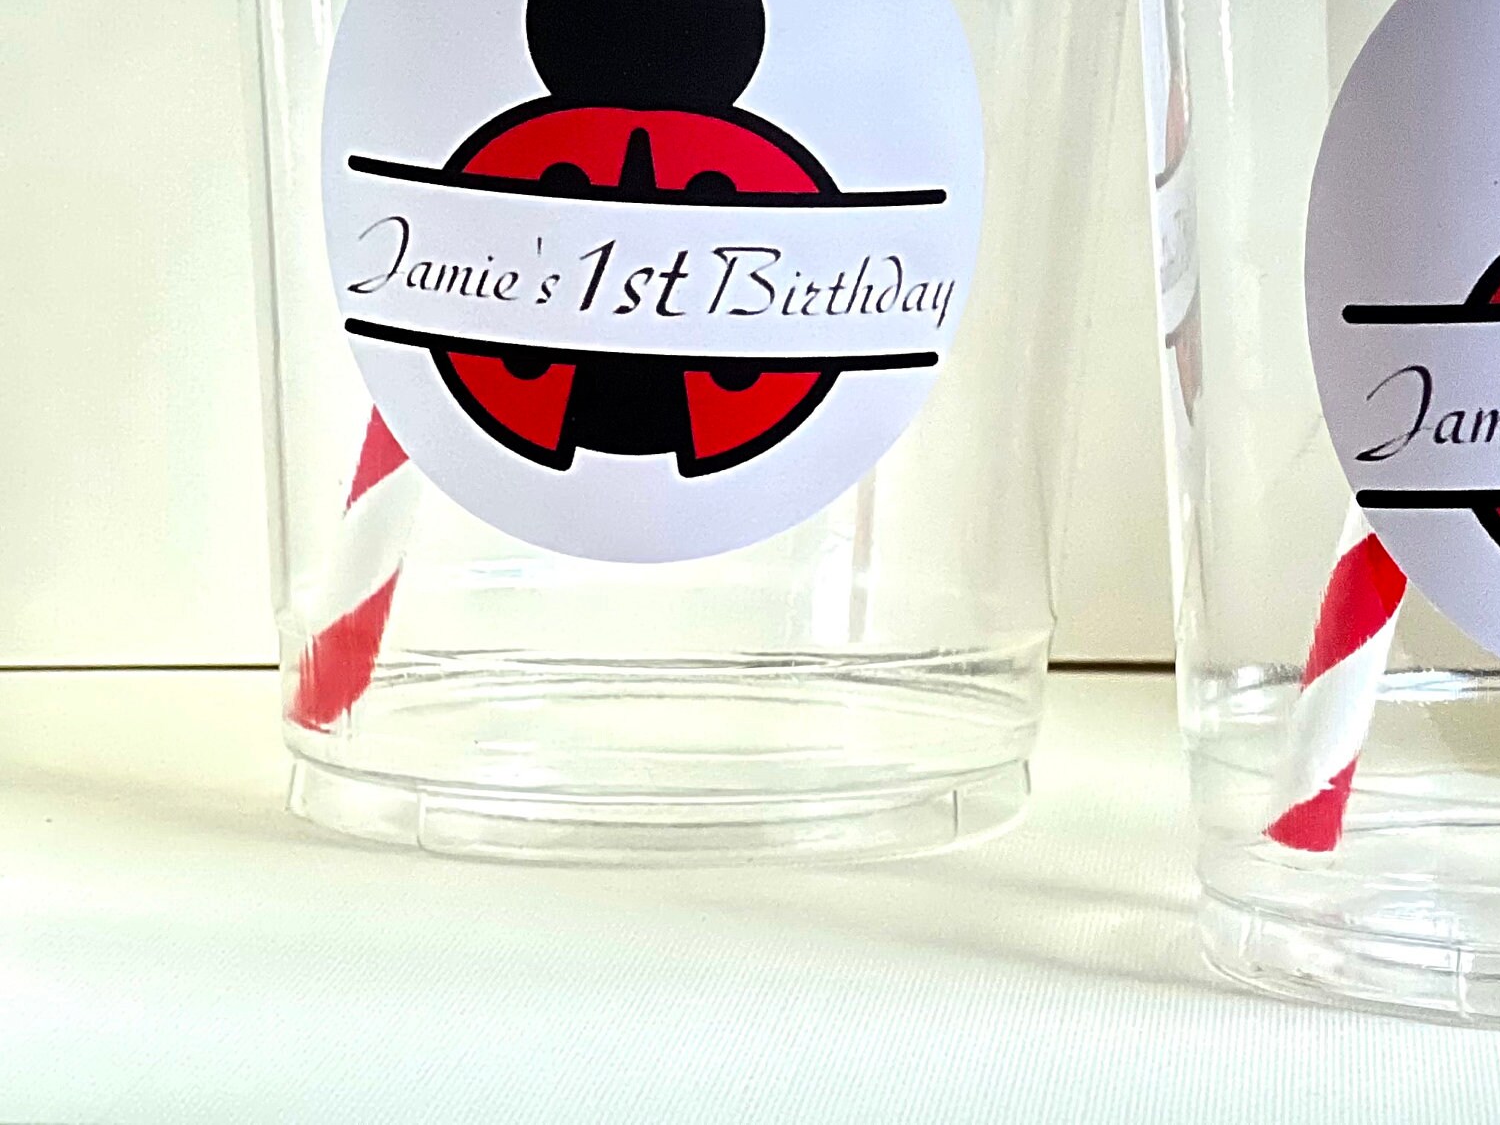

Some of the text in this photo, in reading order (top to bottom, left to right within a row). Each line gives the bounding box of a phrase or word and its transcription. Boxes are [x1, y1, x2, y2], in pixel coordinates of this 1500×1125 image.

[347, 216, 956, 329] Jamie's 1st Birthday
